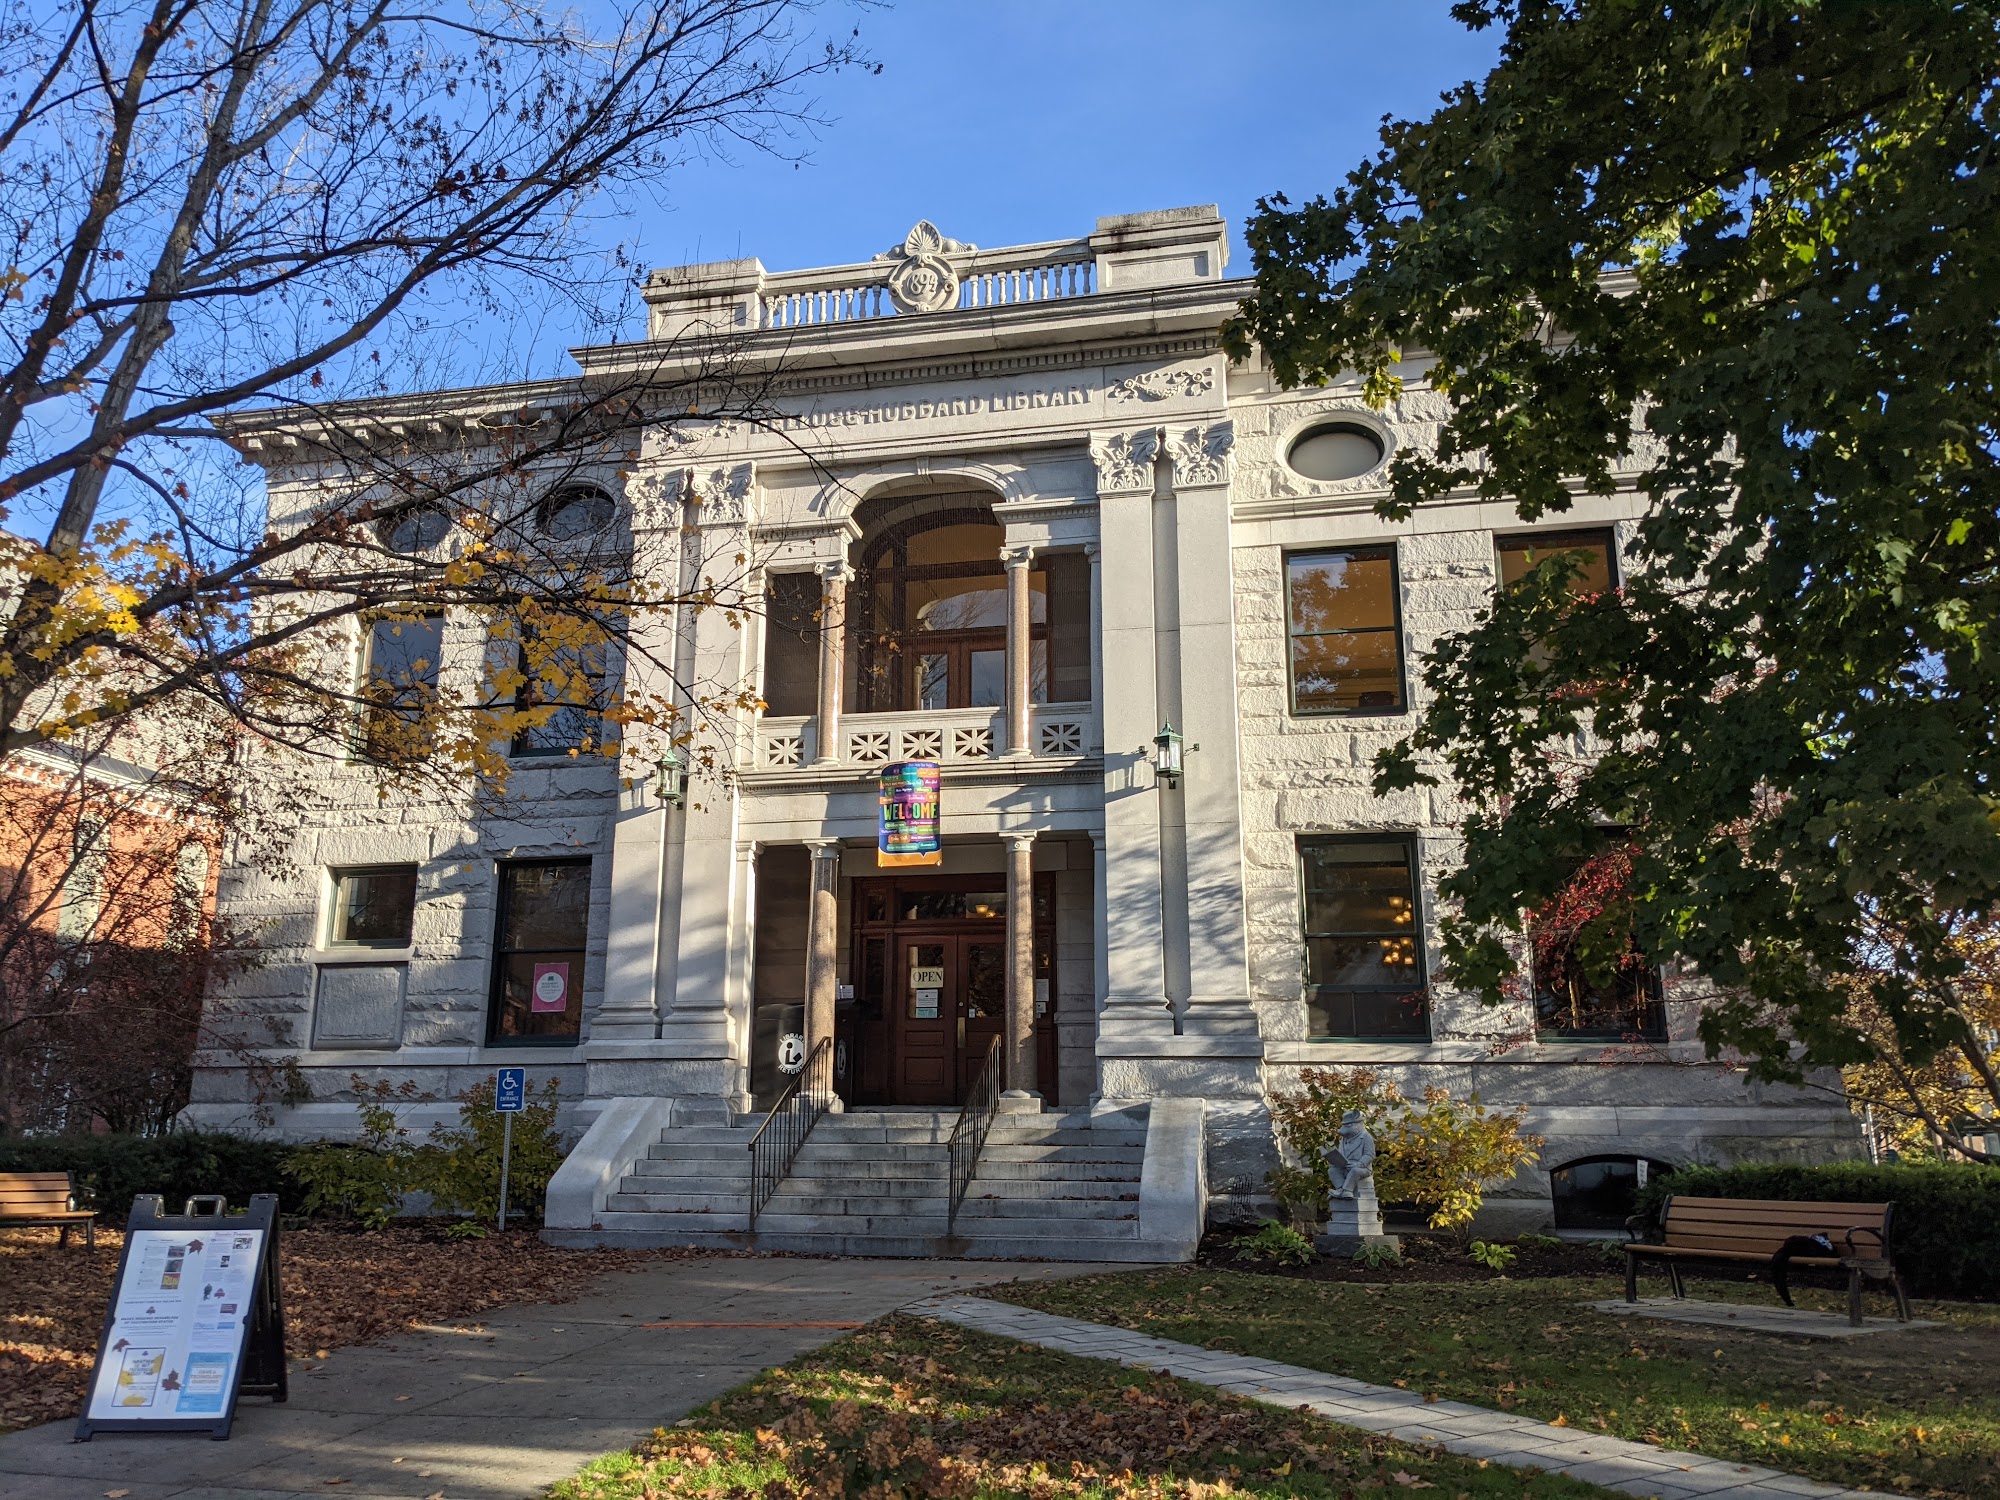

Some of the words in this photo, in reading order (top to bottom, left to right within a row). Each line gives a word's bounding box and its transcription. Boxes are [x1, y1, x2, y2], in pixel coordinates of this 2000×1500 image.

[990, 384, 1096, 412] LIBRARY
[884, 803, 937, 820] WELCOME
[913, 971, 943, 982] OPEN
